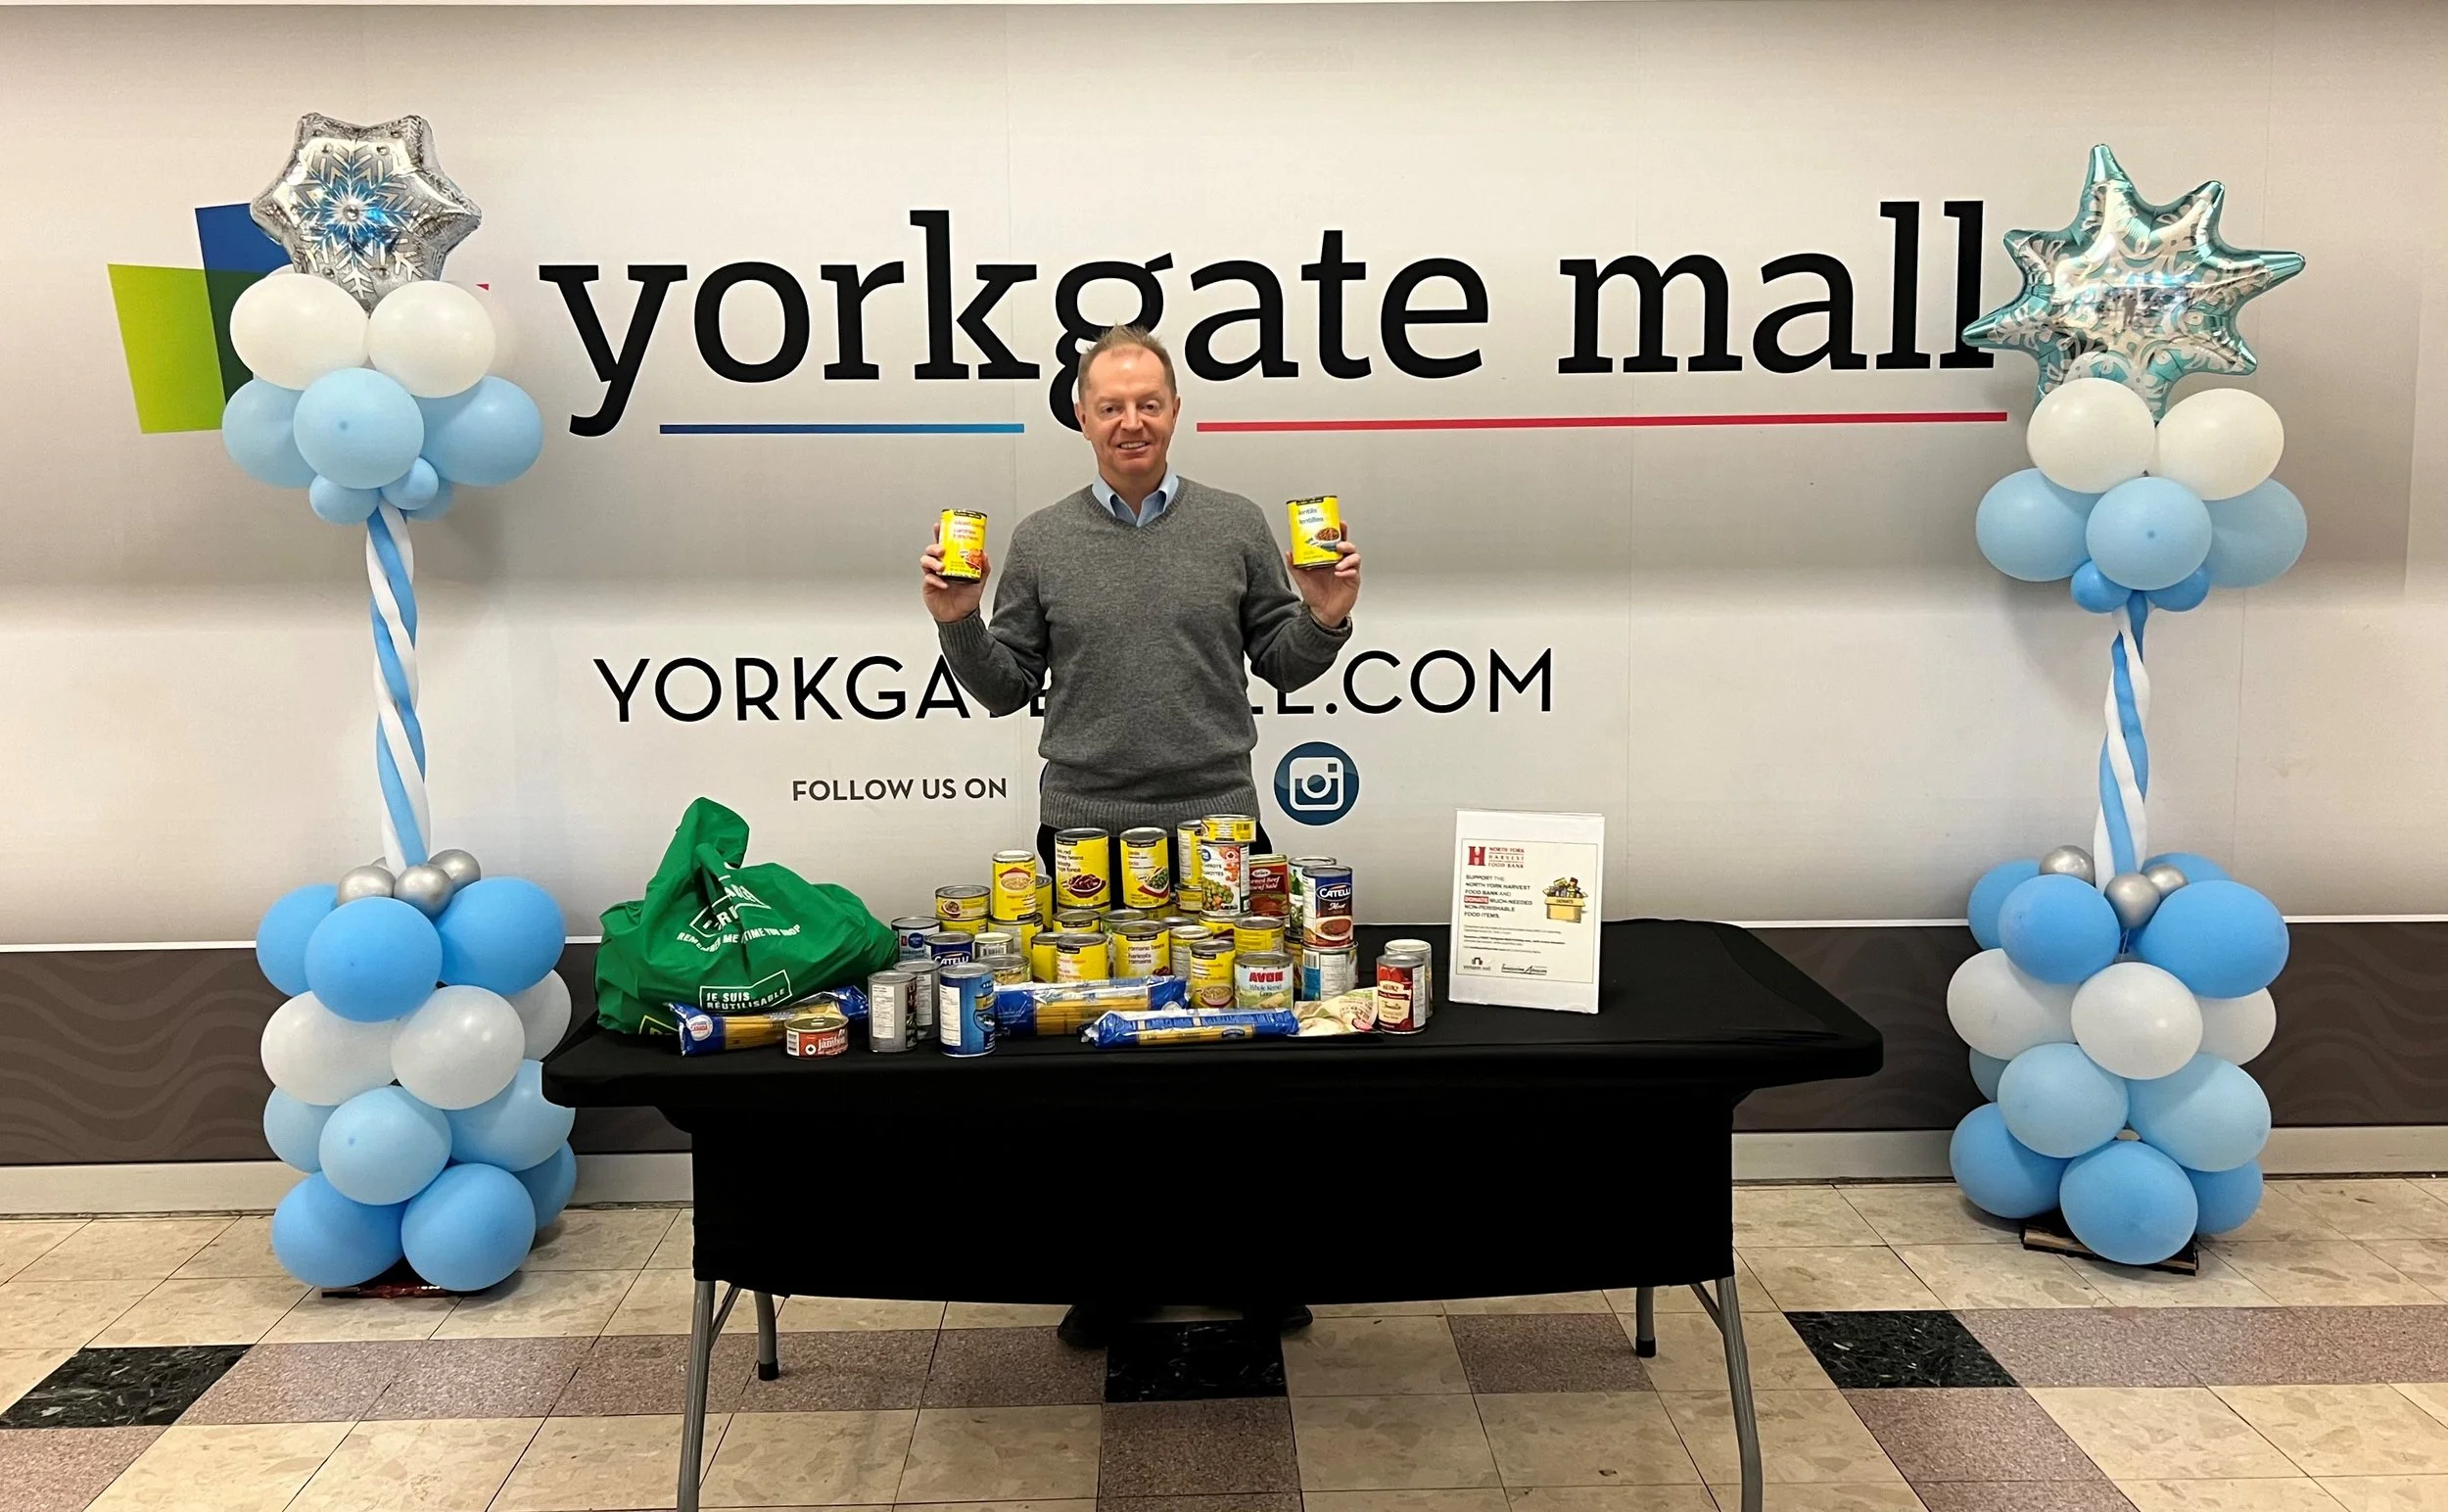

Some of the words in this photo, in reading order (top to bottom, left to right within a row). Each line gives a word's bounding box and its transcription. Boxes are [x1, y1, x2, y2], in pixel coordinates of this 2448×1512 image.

[539, 209, 1489, 437] yorkgate
[1557, 200, 1995, 376] mall
[593, 647, 1551, 723] YORKGAL.COM
[792, 779, 915, 801] FOLLOW
[922, 780, 957, 799] US
[965, 778, 1007, 799] ON
[723, 933, 739, 944] ME
[1248, 970, 1284, 983] AVON
[706, 992, 718, 1003] JE
[722, 991, 750, 1003] SUIS
